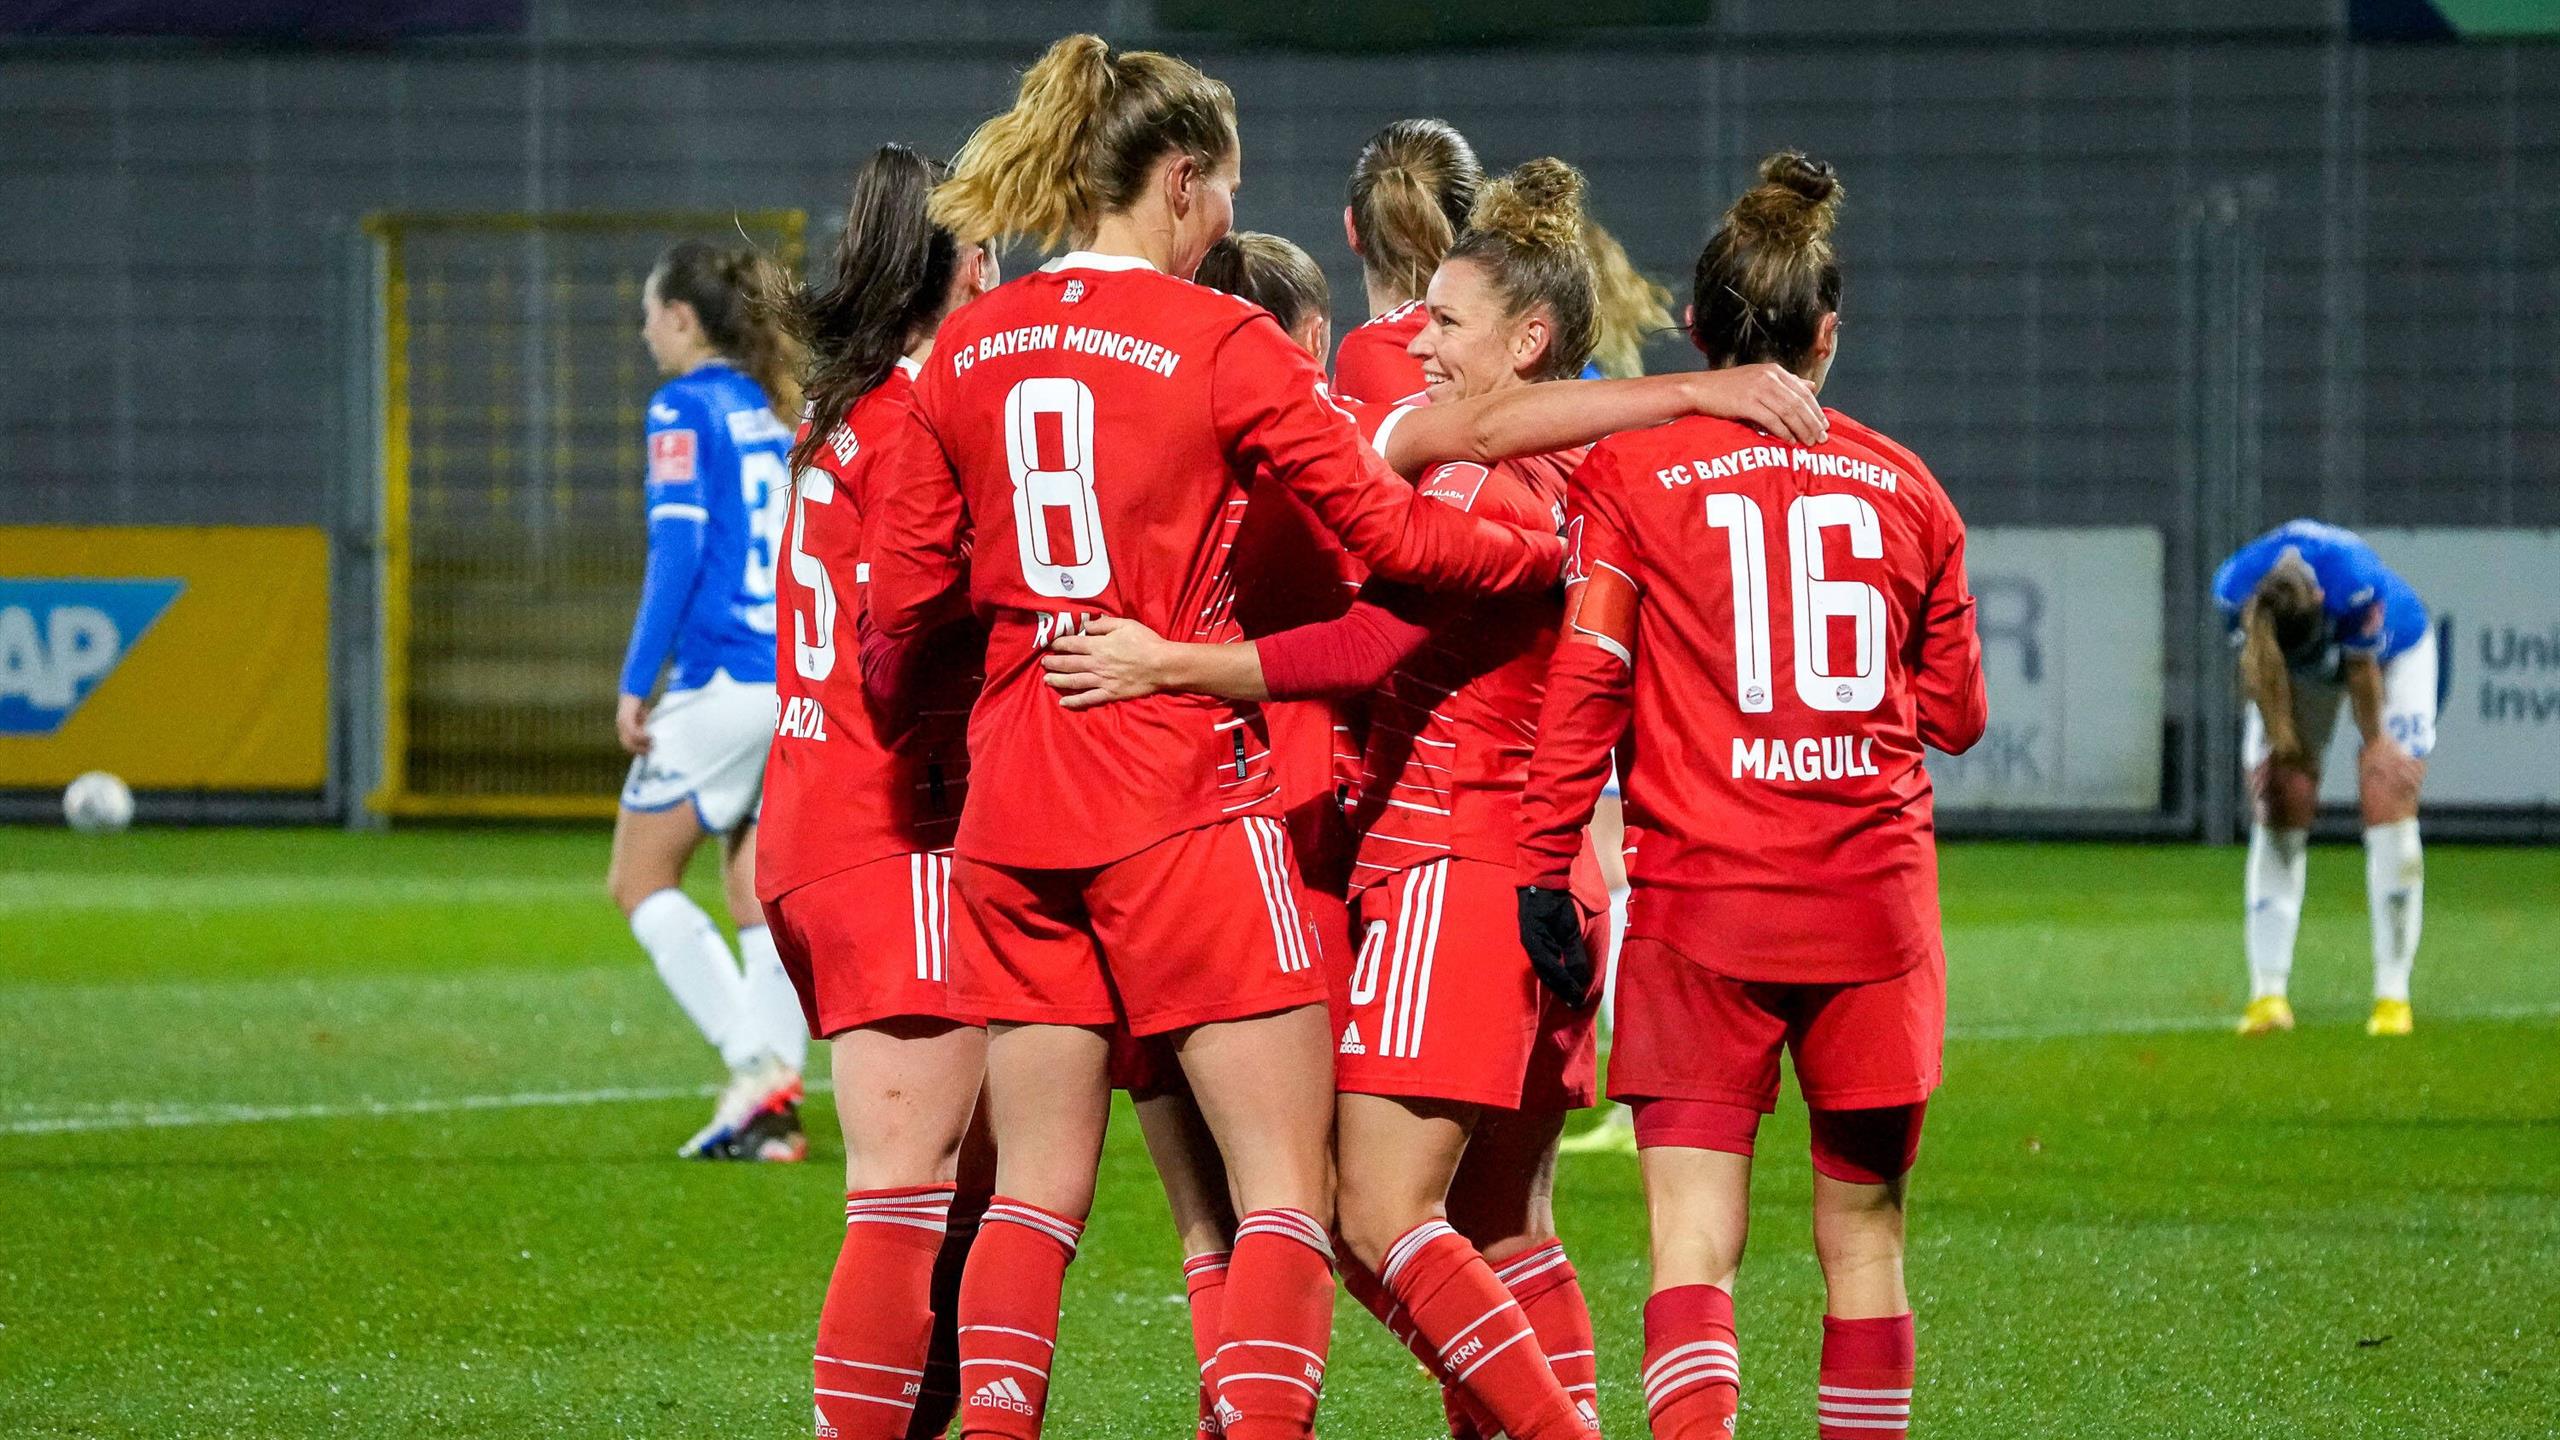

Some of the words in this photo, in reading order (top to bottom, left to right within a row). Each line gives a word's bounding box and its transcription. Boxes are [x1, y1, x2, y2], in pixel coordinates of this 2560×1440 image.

[953, 345, 976, 378] FC
[979, 324, 1059, 362] BAYERN
[1062, 325, 1182, 379] MÜNCHEN
[1004, 377, 1112, 599] 8
[1656, 465, 1692, 490] FC
[1693, 446, 1789, 480] BAYERN
[1705, 492, 1888, 713] 16
[0, 604, 121, 708] AP
[775, 694, 828, 743] AZIL
[1731, 734, 1880, 781] MAGULL
[969, 1393, 1034, 1417] adidas
